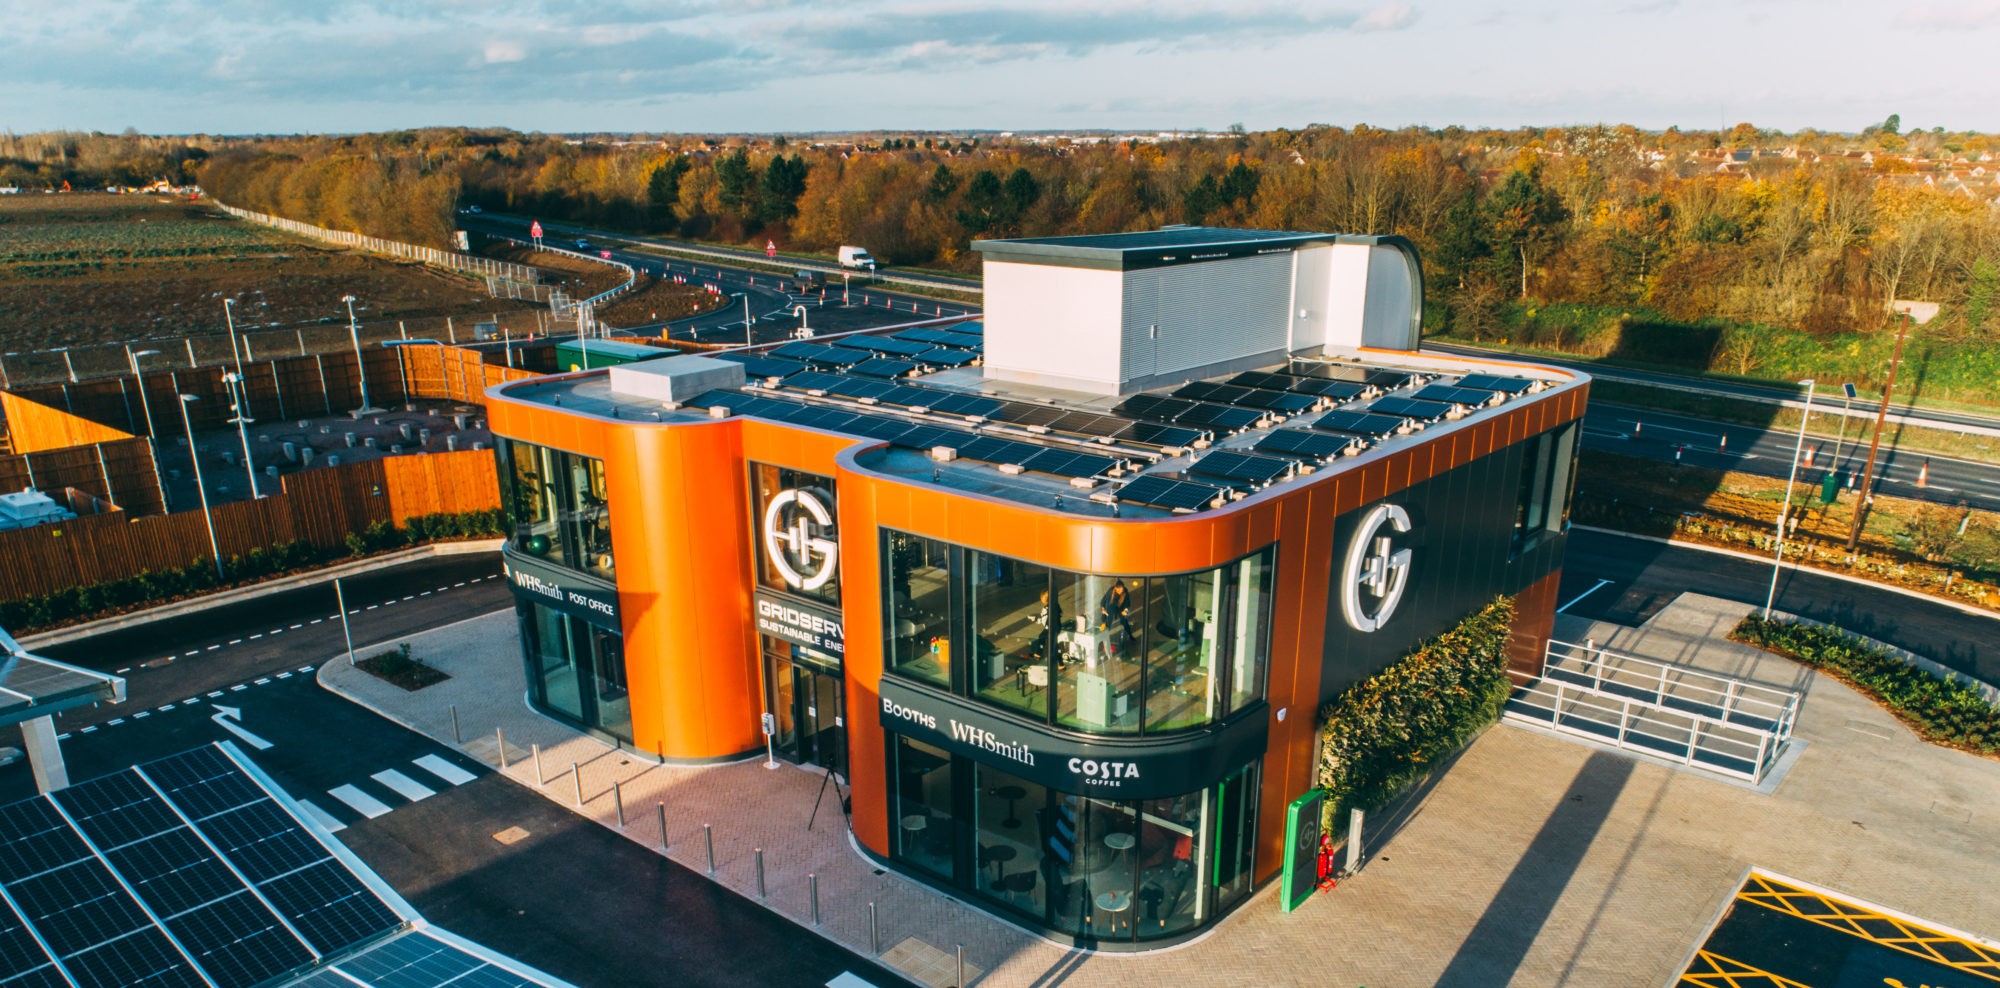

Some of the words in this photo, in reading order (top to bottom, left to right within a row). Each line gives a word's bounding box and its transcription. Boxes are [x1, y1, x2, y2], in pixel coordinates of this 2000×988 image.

[515, 570, 563, 601] WHSmith
[569, 592, 587, 606] POST
[588, 598, 614, 616] OFFICE
[760, 618, 821, 646] SUSTAINABLE
[824, 639, 844, 654] ENE
[950, 719, 1035, 767] WHSmith
[1068, 757, 1140, 779] COSTA
[1085, 778, 1121, 787] COFFEE
